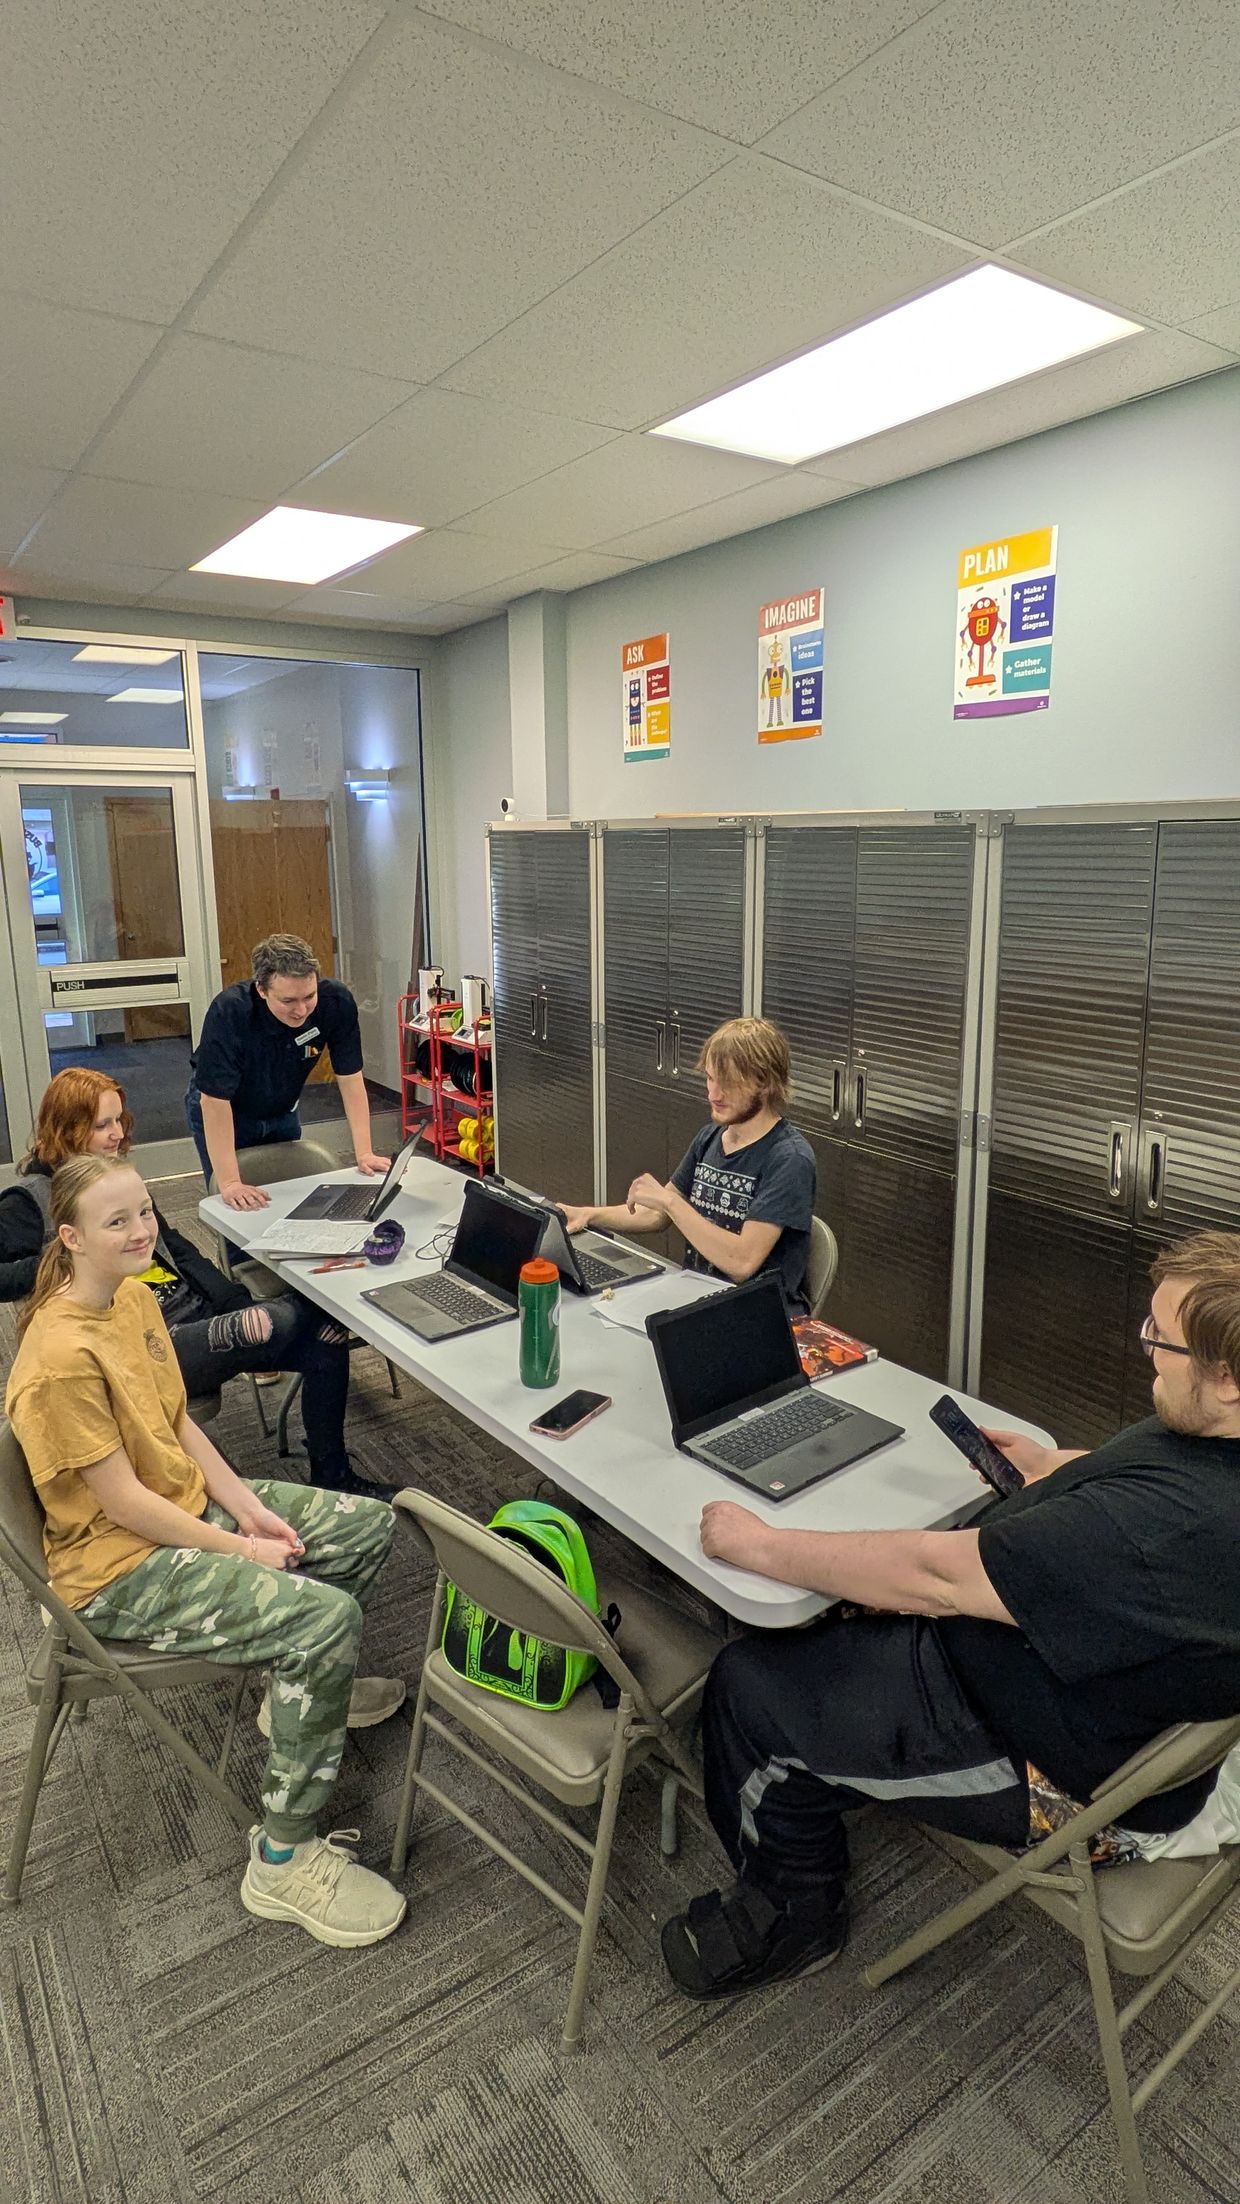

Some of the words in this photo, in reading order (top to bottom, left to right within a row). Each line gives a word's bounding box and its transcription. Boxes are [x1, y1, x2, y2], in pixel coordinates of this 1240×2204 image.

[963, 545, 1009, 579] PLAN
[1023, 586, 1041, 595] Make
[1023, 593, 1045, 604] model
[764, 596, 816, 628] IMAGINE
[1022, 613, 1040, 622] draw
[1021, 620, 1050, 631] diagram
[626, 645, 645, 665] ASK
[798, 651, 815, 660] ideas
[1014, 658, 1042, 669] Gather
[1013, 666, 1047, 678] materials
[802, 677, 815, 687] Pick
[801, 688, 812, 696] the
[801, 697, 815, 706] best
[56, 981, 85, 991] PUSH
